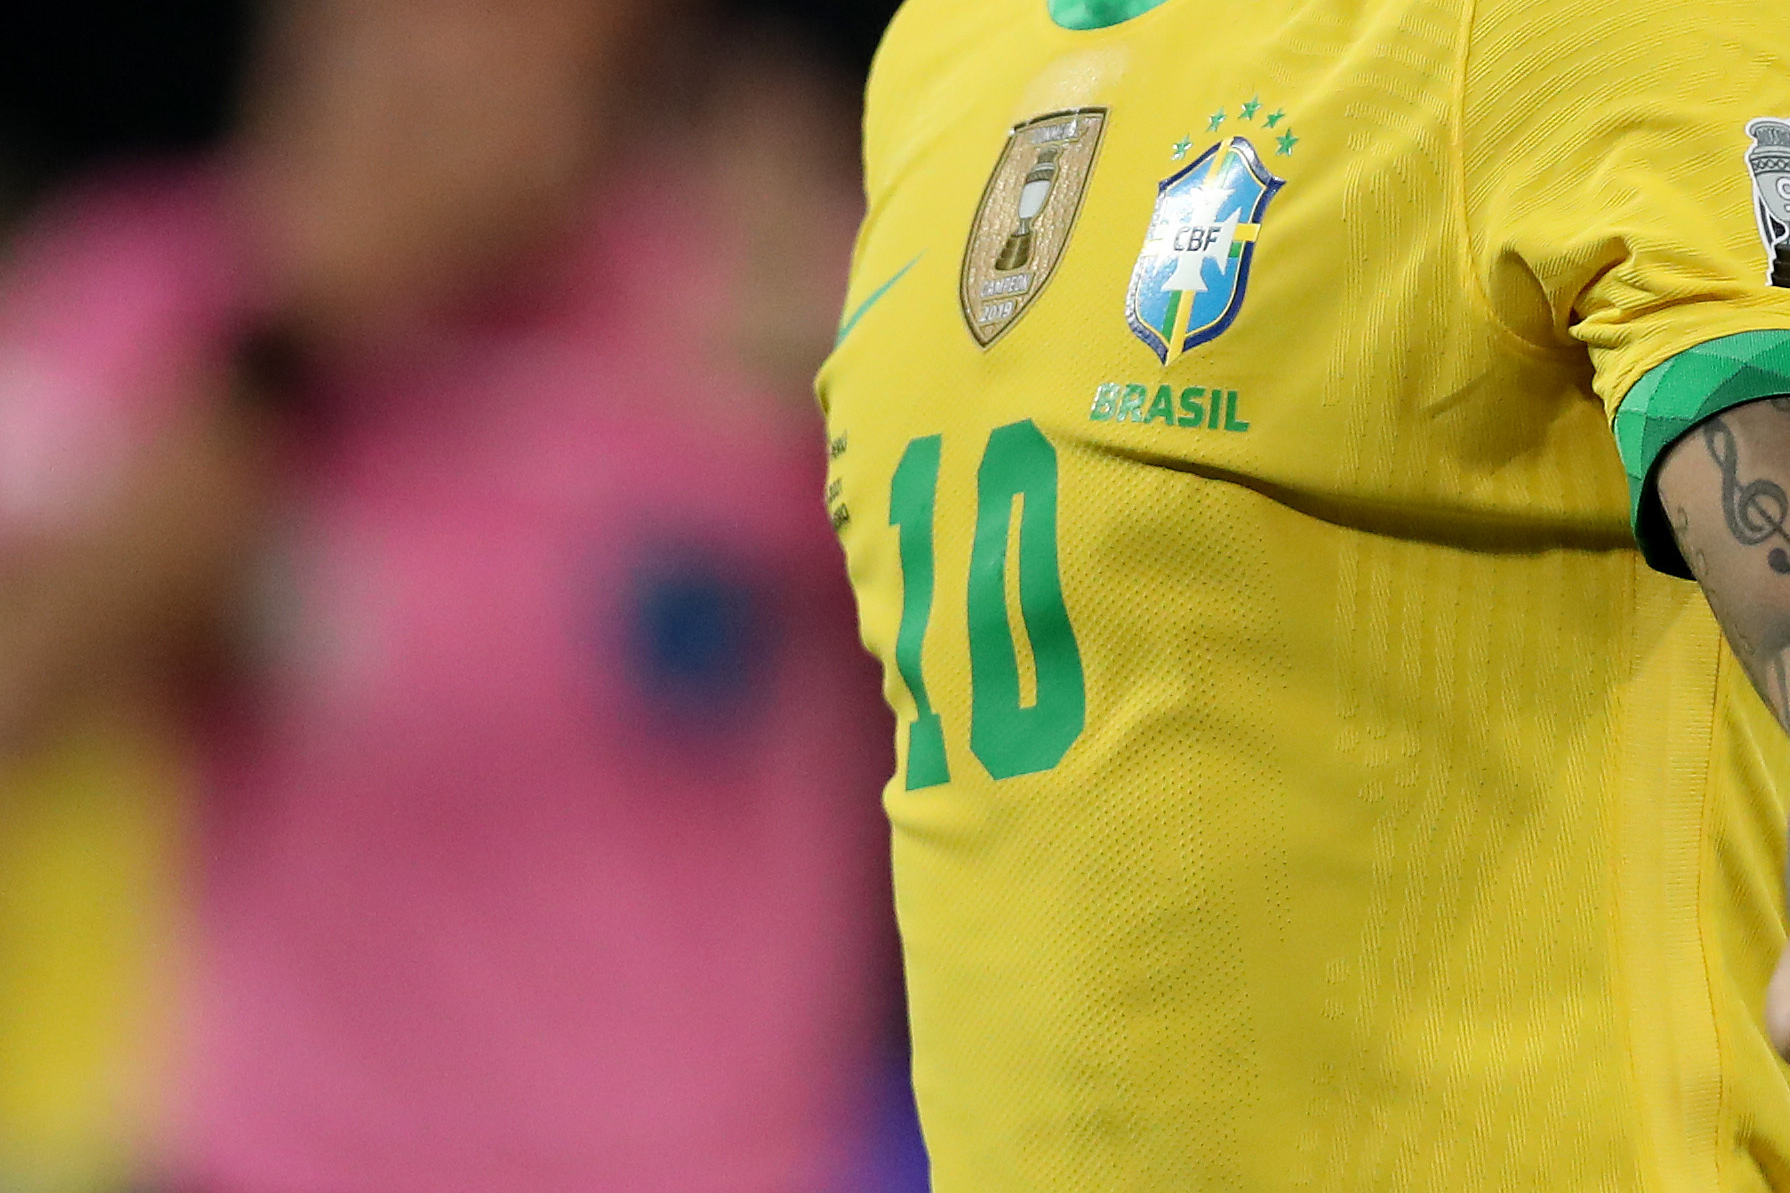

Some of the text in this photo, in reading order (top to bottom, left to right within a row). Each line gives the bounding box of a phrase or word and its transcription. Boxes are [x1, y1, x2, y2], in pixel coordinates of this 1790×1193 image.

[1173, 226, 1223, 252] CBF
[1089, 382, 1250, 432] BRASIL
[889, 418, 1086, 792] 10
